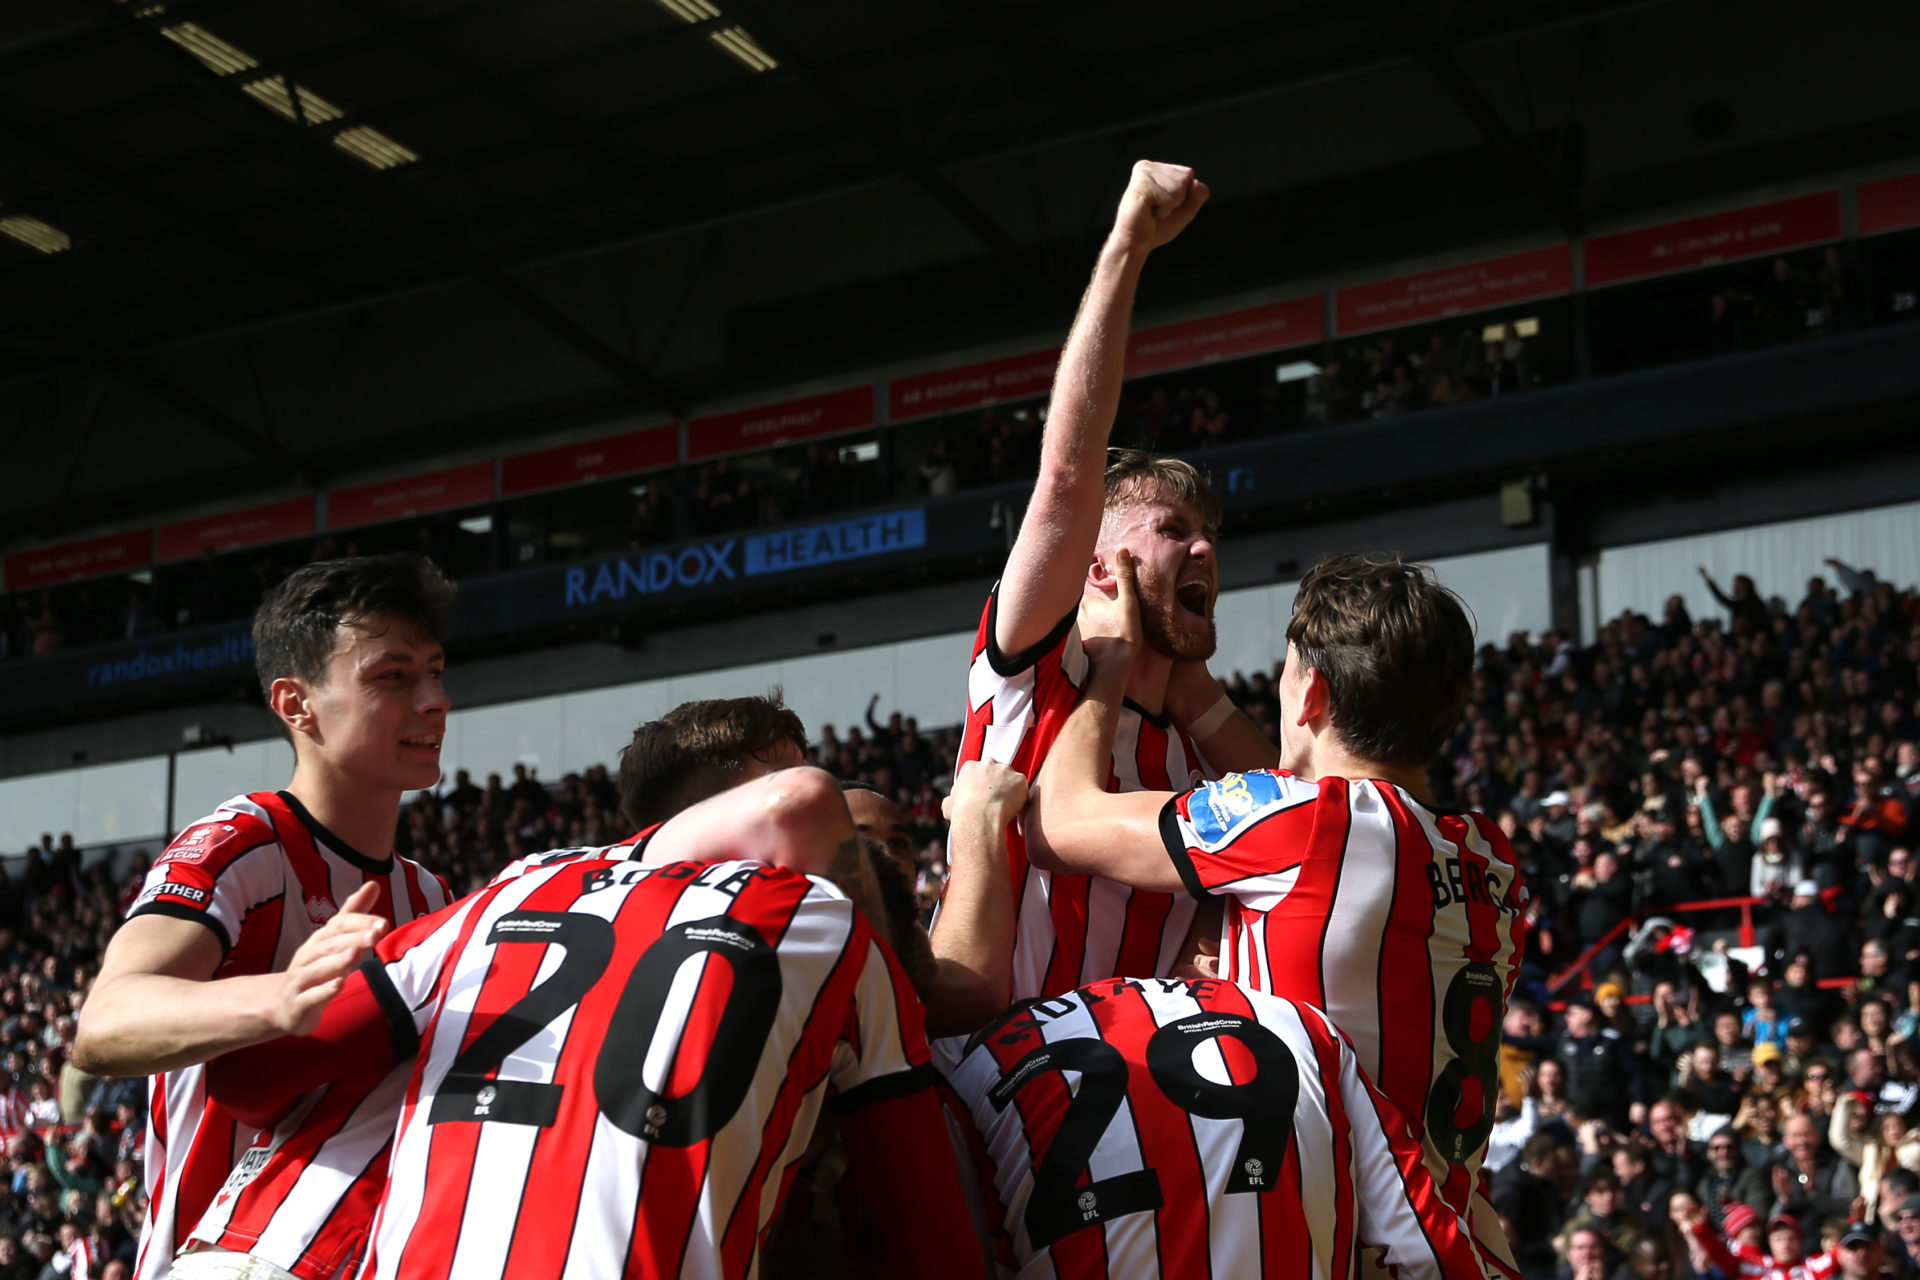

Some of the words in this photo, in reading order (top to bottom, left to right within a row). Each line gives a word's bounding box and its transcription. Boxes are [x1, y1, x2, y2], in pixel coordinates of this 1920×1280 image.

[564, 540, 736, 607] RANDOX
[765, 516, 904, 567] HEALTH
[427, 909, 784, 1149] 20
[1177, 1019, 1242, 1031] BritishRedCross
[1426, 961, 1504, 1166] 8
[474, 1105, 490, 1116] EFL
[986, 1010, 1300, 1252] 29
[1248, 1176, 1264, 1185] EFL
[1082, 1209, 1100, 1221] EFL
